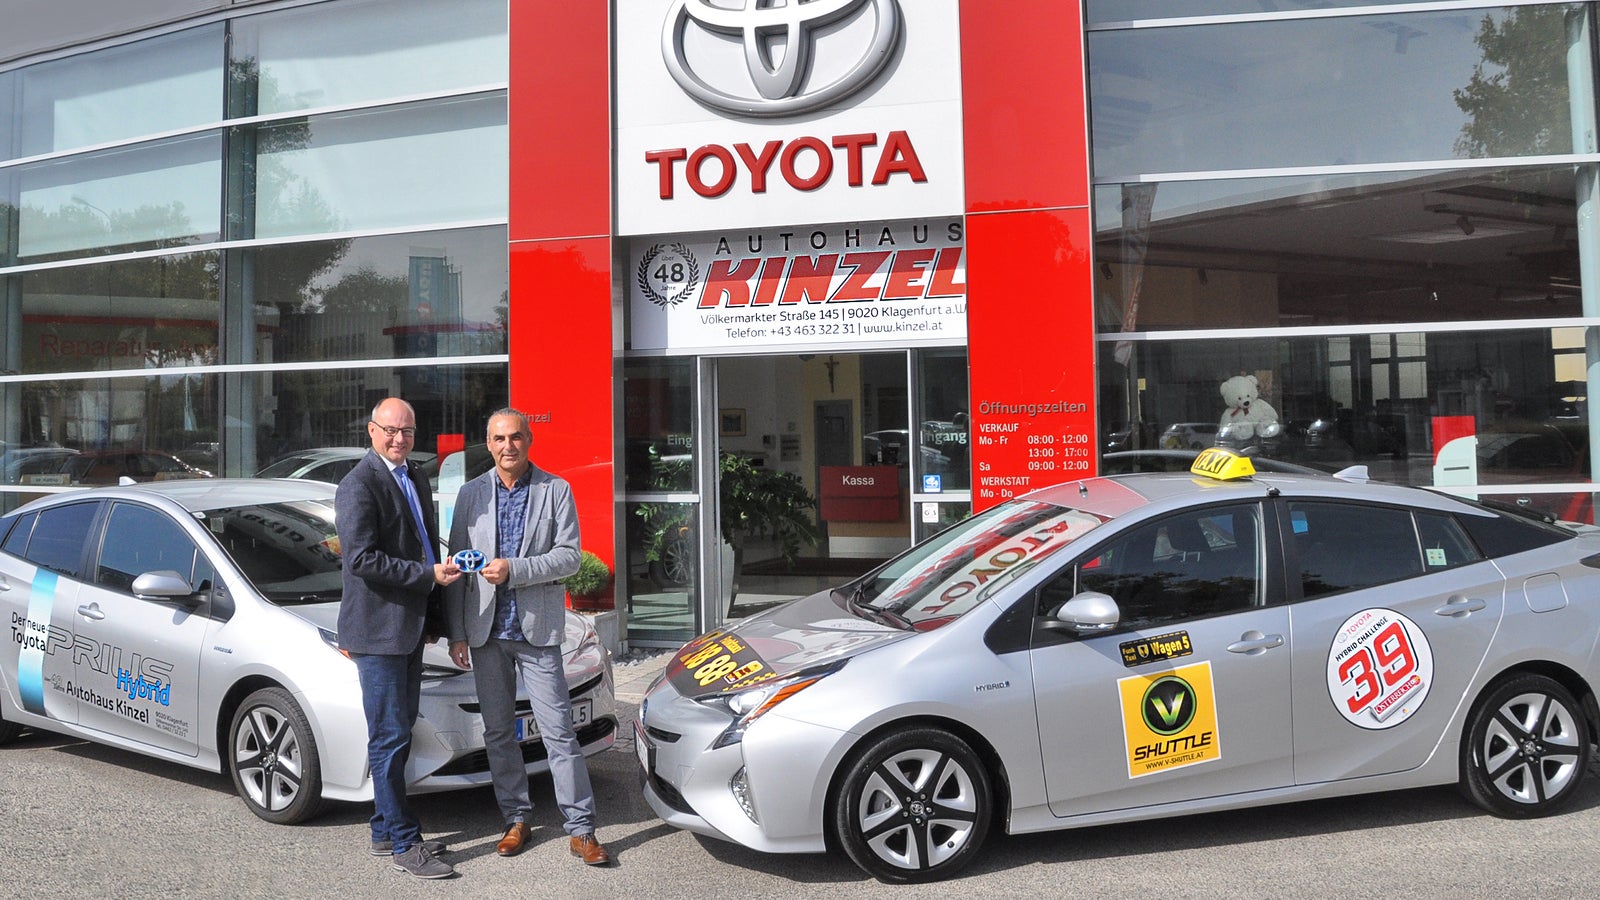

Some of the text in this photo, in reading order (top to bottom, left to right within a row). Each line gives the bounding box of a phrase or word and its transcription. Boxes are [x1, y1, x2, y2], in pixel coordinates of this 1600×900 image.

[645, 130, 928, 200] TOYOTA
[715, 222, 963, 255] AUTOHAUS
[653, 263, 684, 283] 48
[696, 247, 966, 309] KINZEL
[700, 312, 776, 325] Völkermarkter
[779, 310, 816, 322] Straße
[819, 309, 839, 320] 145
[848, 307, 879, 319] 9020
[882, 305, 942, 319] Klagenfurt
[726, 327, 767, 339] Telefon:
[770, 326, 792, 337] +43
[794, 325, 817, 336] 463
[819, 324, 840, 335] 322
[842, 323, 855, 334] 31
[863, 321, 943, 334] www.kinzel.at
[979, 400, 1087, 417] Öffnungszeiten
[979, 423, 1019, 433] VERKAUF
[979, 435, 993, 445] Mo
[999, 435, 1009, 445] Fr
[1027, 434, 1054, 445] 08:00
[1062, 434, 1088, 444] 12:00
[1029, 448, 1054, 458] 13:00
[1065, 447, 1088, 457] 17:00
[1194, 451, 1232, 474] TAXI
[979, 462, 991, 471] Sa
[1028, 461, 1055, 471] 09:00
[1063, 460, 1089, 470] 12:00
[842, 474, 875, 487] Kassa
[980, 476, 1030, 486] WERKSTATT
[980, 488, 994, 498] Mo
[1001, 488, 1013, 498] Do
[11, 611, 46, 634] Der neue
[1346, 612, 1372, 635] TOYOTA
[11, 626, 46, 652] Toyota
[1150, 636, 1190, 656] Wagen 5
[1335, 642, 1358, 662] HYBRID
[1357, 616, 1388, 645] CHALLENGE
[46, 624, 174, 684] PRIUS
[1122, 647, 1135, 655] Funk
[1124, 654, 1137, 662] Taxi
[1338, 621, 1415, 714] 39
[117, 667, 171, 707] Hybrid
[975, 682, 1005, 692] HYBRID
[66, 681, 149, 724] Autohaus Kinzel
[1374, 681, 1413, 714] ÖSTERREICH
[580, 706, 587, 722] 5
[1151, 691, 1186, 726] V
[1134, 731, 1213, 761] SHUTTLE
[1145, 751, 1204, 770] WWW.V-SHUTTLE.AT
